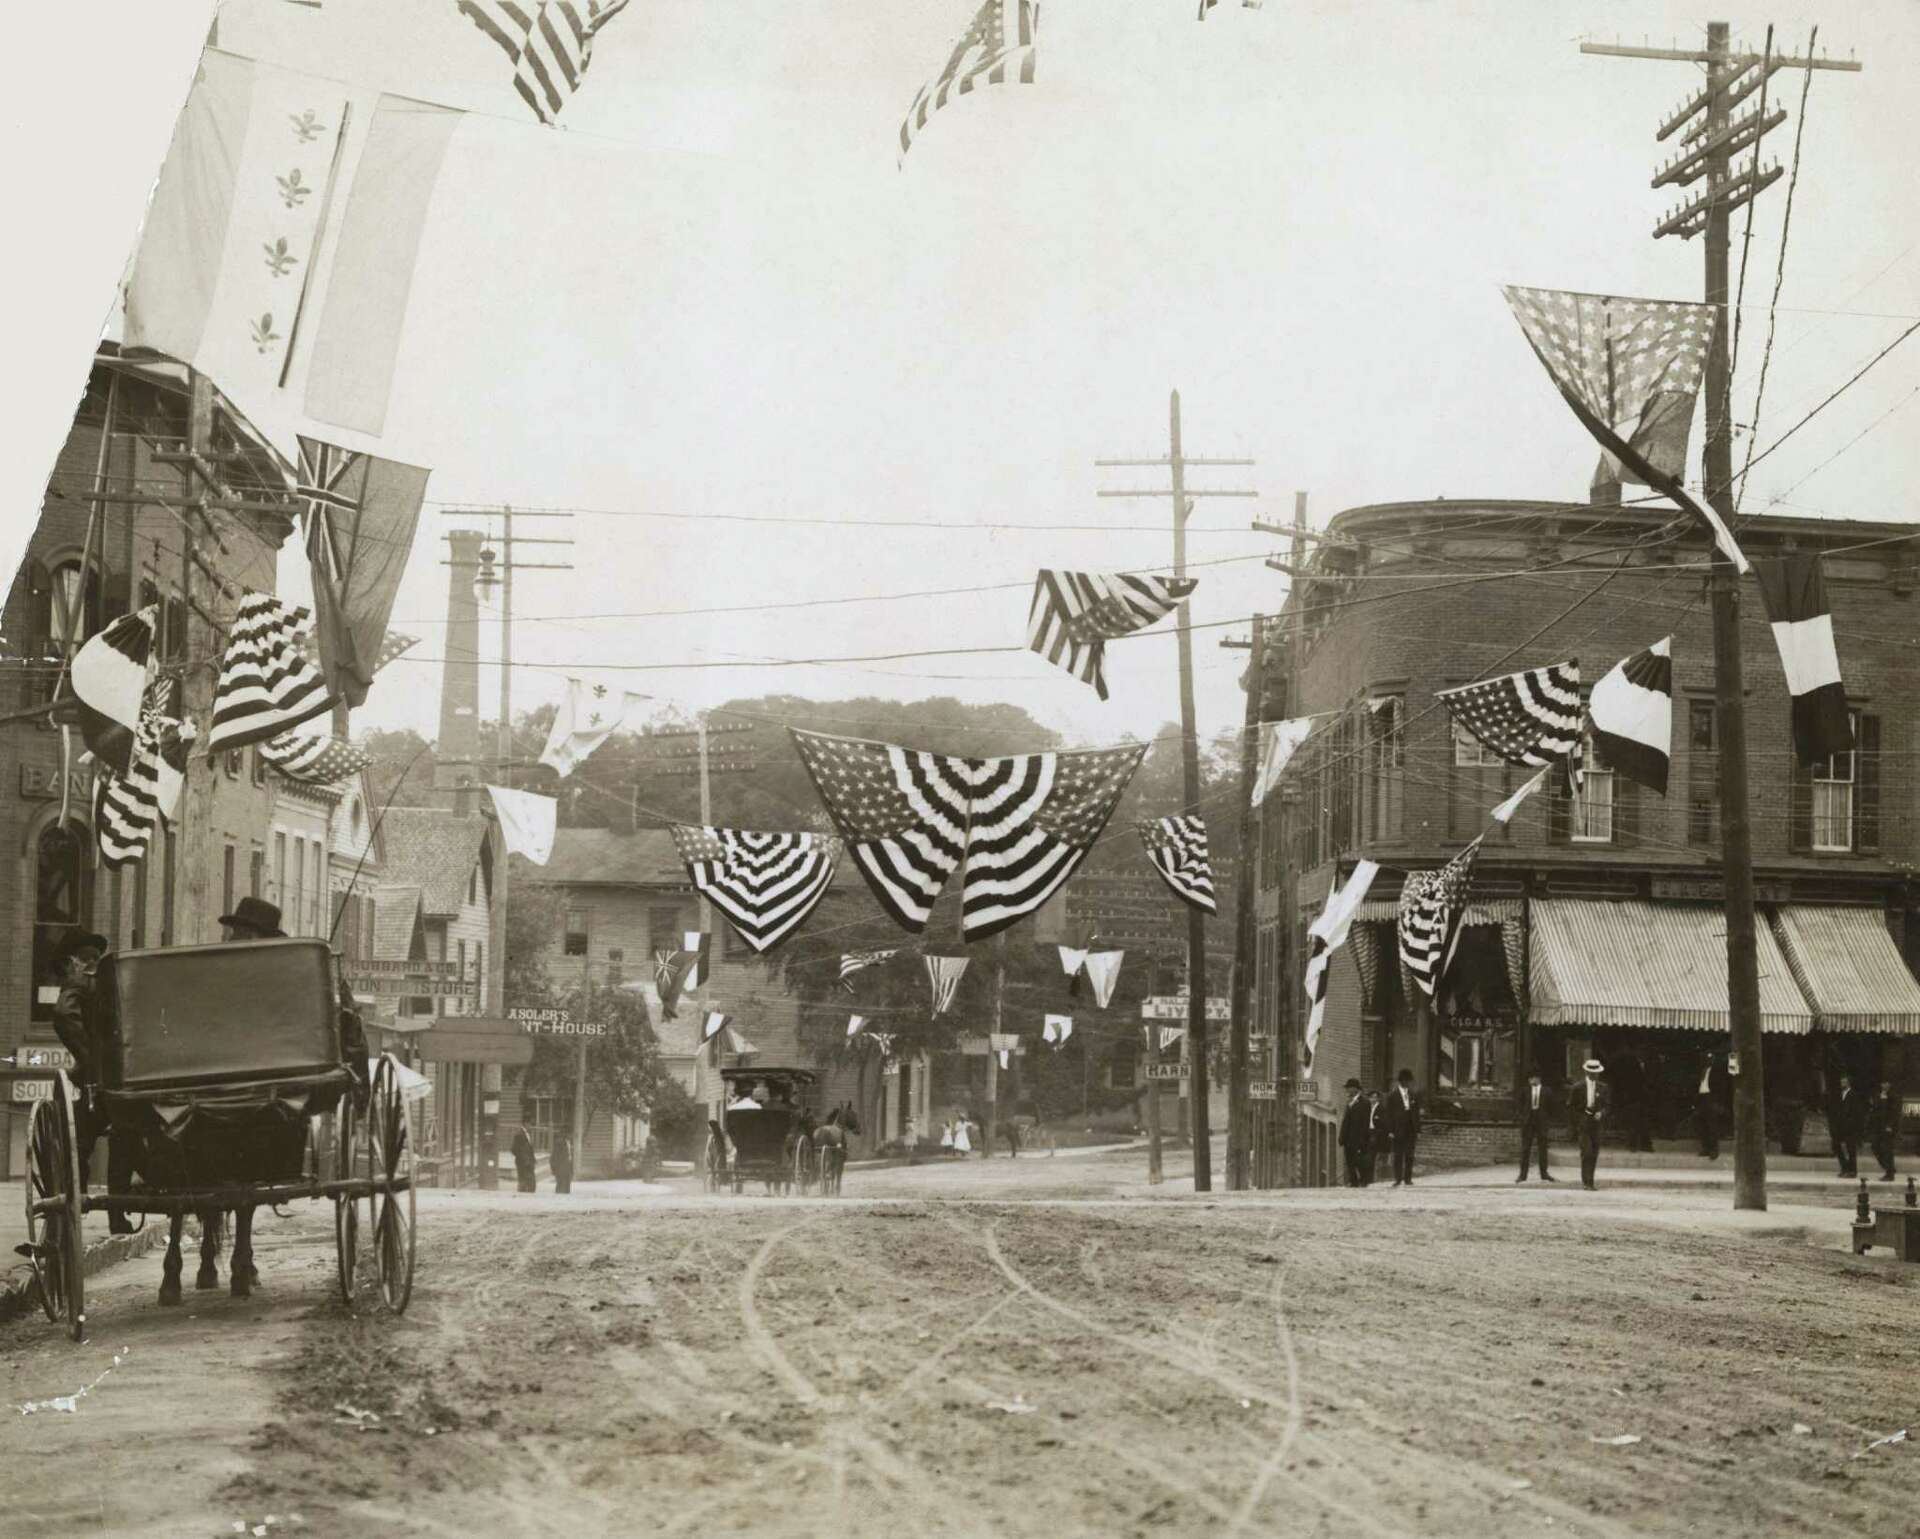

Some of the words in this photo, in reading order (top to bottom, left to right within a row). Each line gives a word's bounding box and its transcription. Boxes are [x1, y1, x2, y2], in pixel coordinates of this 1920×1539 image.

[26, 768, 90, 795] BAN
[519, 1020, 607, 1036] NT-HOUSE
[27, 1050, 74, 1067] KODA
[1148, 1065, 1189, 1079] HARN
